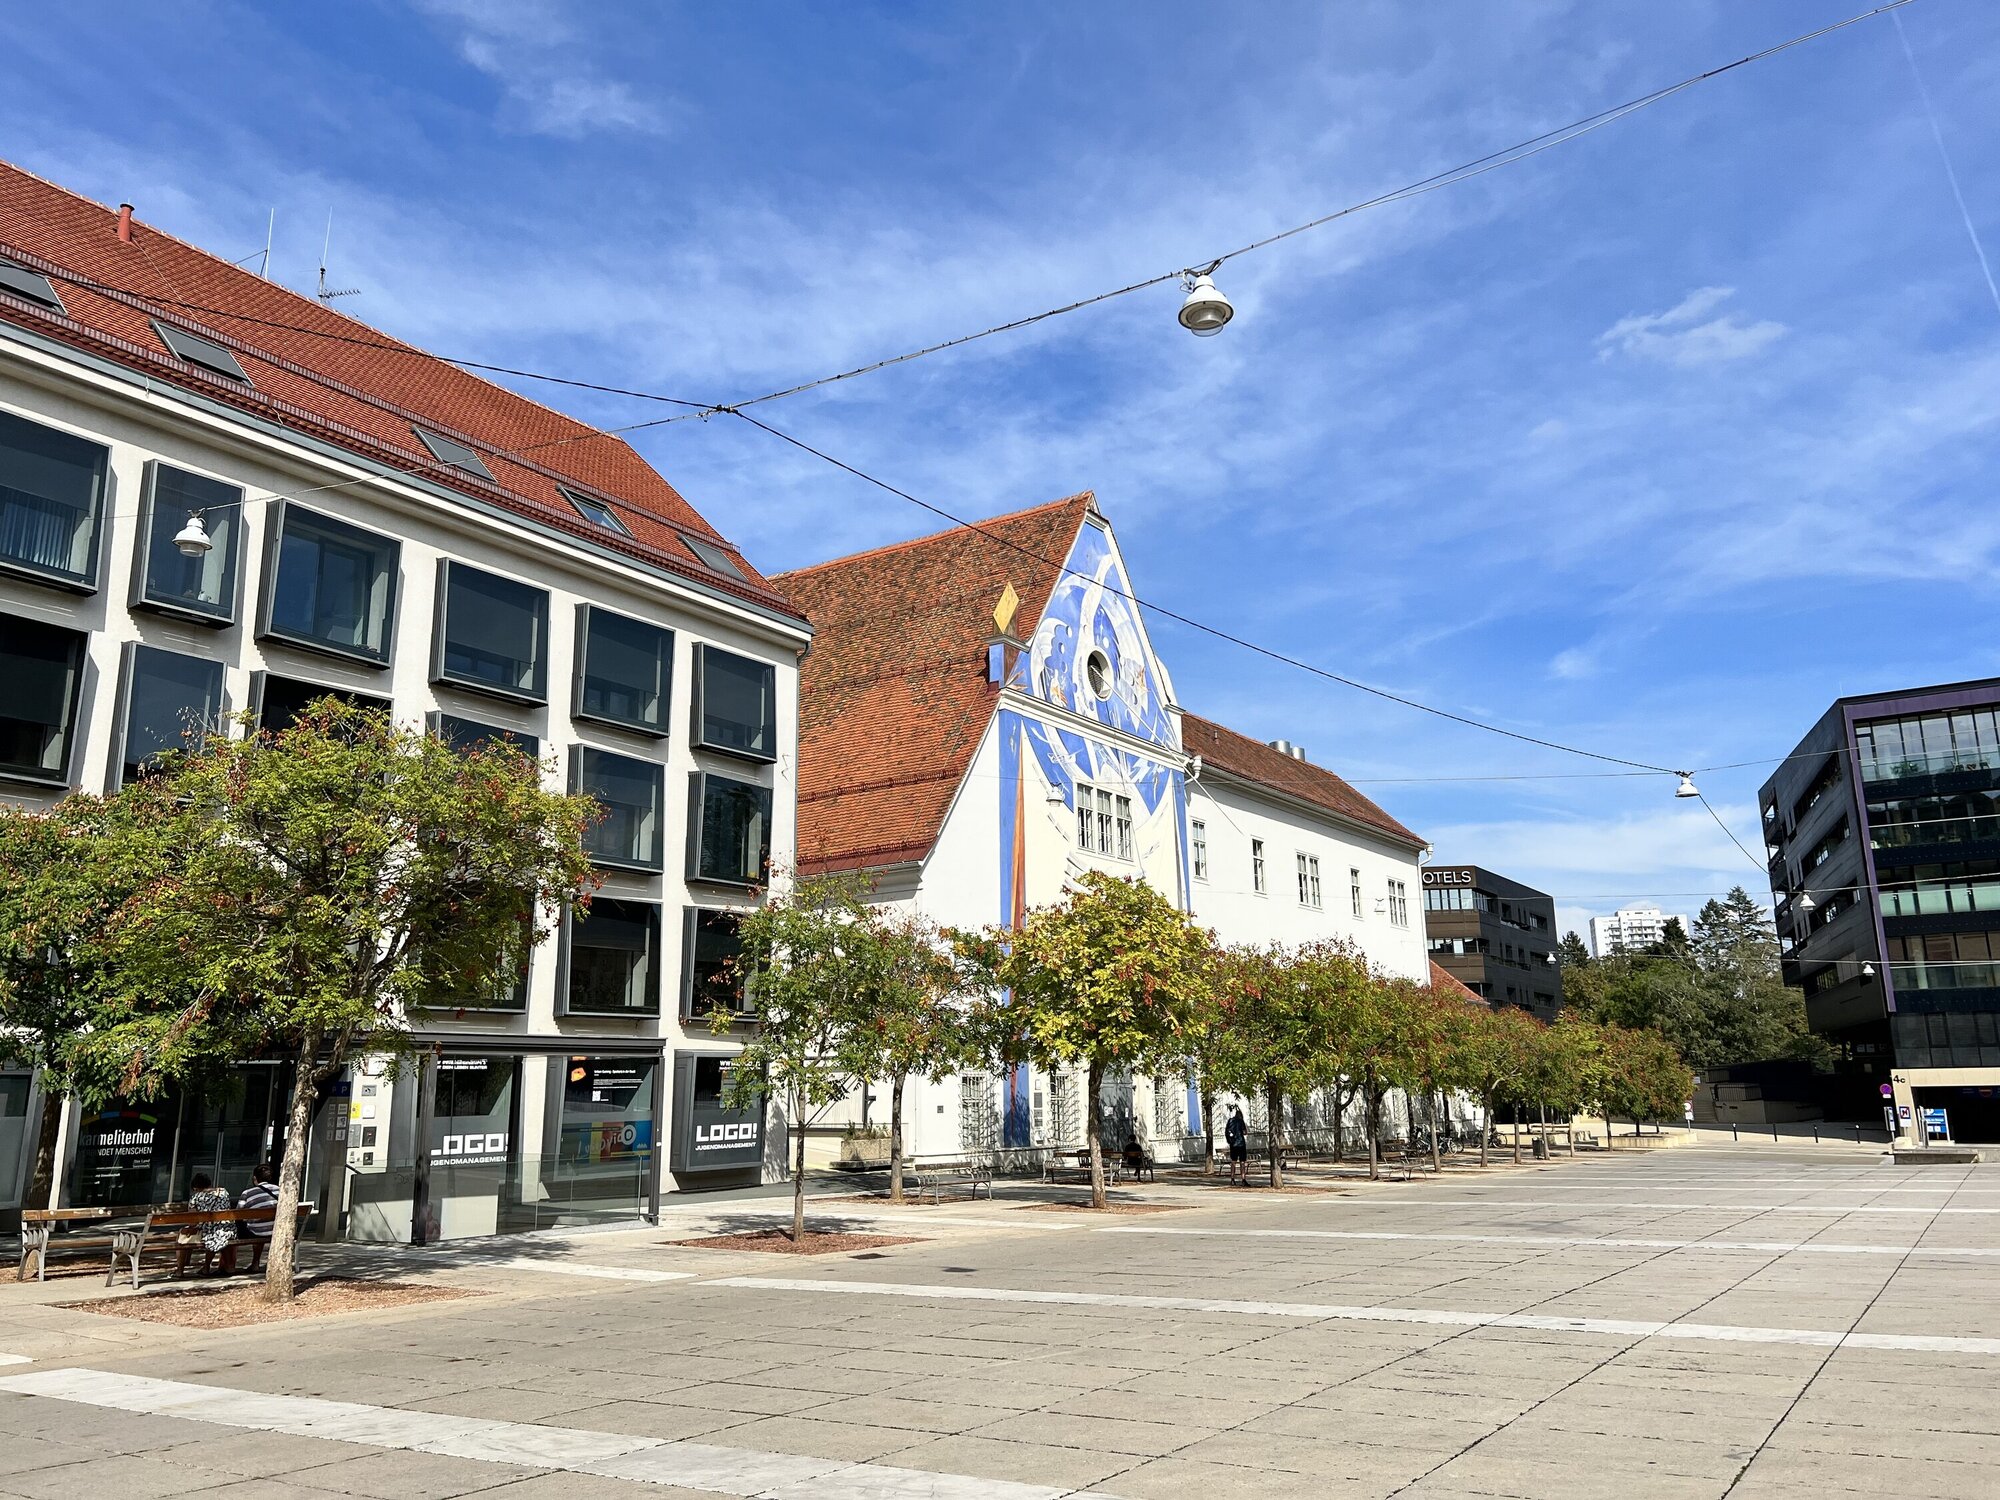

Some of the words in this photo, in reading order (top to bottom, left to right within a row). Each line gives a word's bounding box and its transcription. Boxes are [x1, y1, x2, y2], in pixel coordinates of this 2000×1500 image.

[1422, 870, 1472, 884] OTELS
[696, 1122, 758, 1143] LOGO!
[115, 1146, 153, 1156] MENSCHEN
[695, 1141, 757, 1151] JUGENDMANAGEMENT
